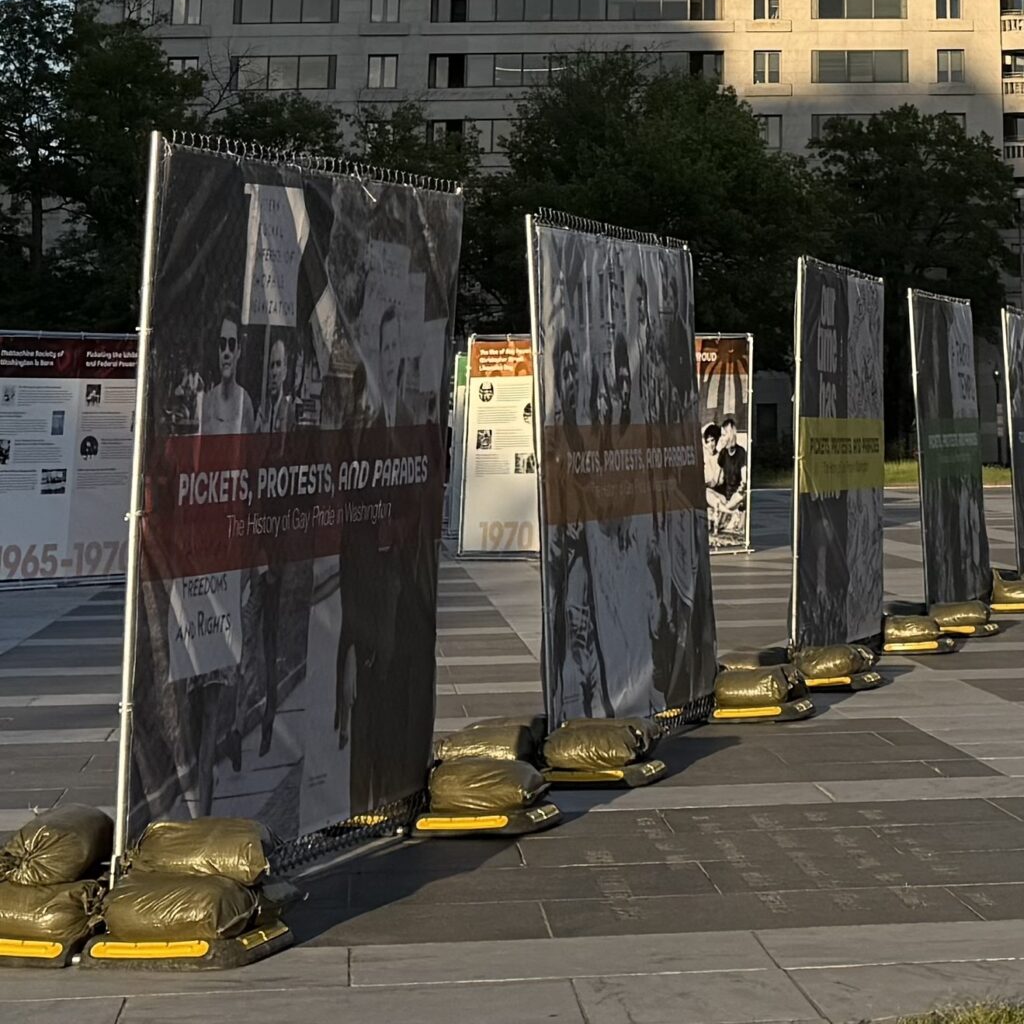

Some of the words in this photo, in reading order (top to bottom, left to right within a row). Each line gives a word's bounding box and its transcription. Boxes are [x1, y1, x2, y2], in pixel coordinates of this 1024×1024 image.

[0, 359, 34, 368] Washington
[35, 350, 56, 359] Society
[57, 349, 65, 357] of
[86, 351, 112, 359] Picketing
[112, 351, 122, 359] the
[97, 360, 117, 368] Federal
[178, 469, 253, 507] PICKETS,
[257, 462, 336, 499] PROTESTS,
[338, 459, 371, 492] AND
[371, 454, 428, 488] PARADES
[226, 514, 246, 539] The
[246, 512, 281, 538] History
[281, 508, 291, 532] of
[291, 506, 311, 534] Gay
[311, 504, 336, 528] Pride
[336, 507, 344, 528] in
[345, 499, 392, 526] Washington
[479, 520, 534, 550] 1970
[0, 540, 129, 580] 965-1970
[182, 572, 228, 599] FREEDOMS
